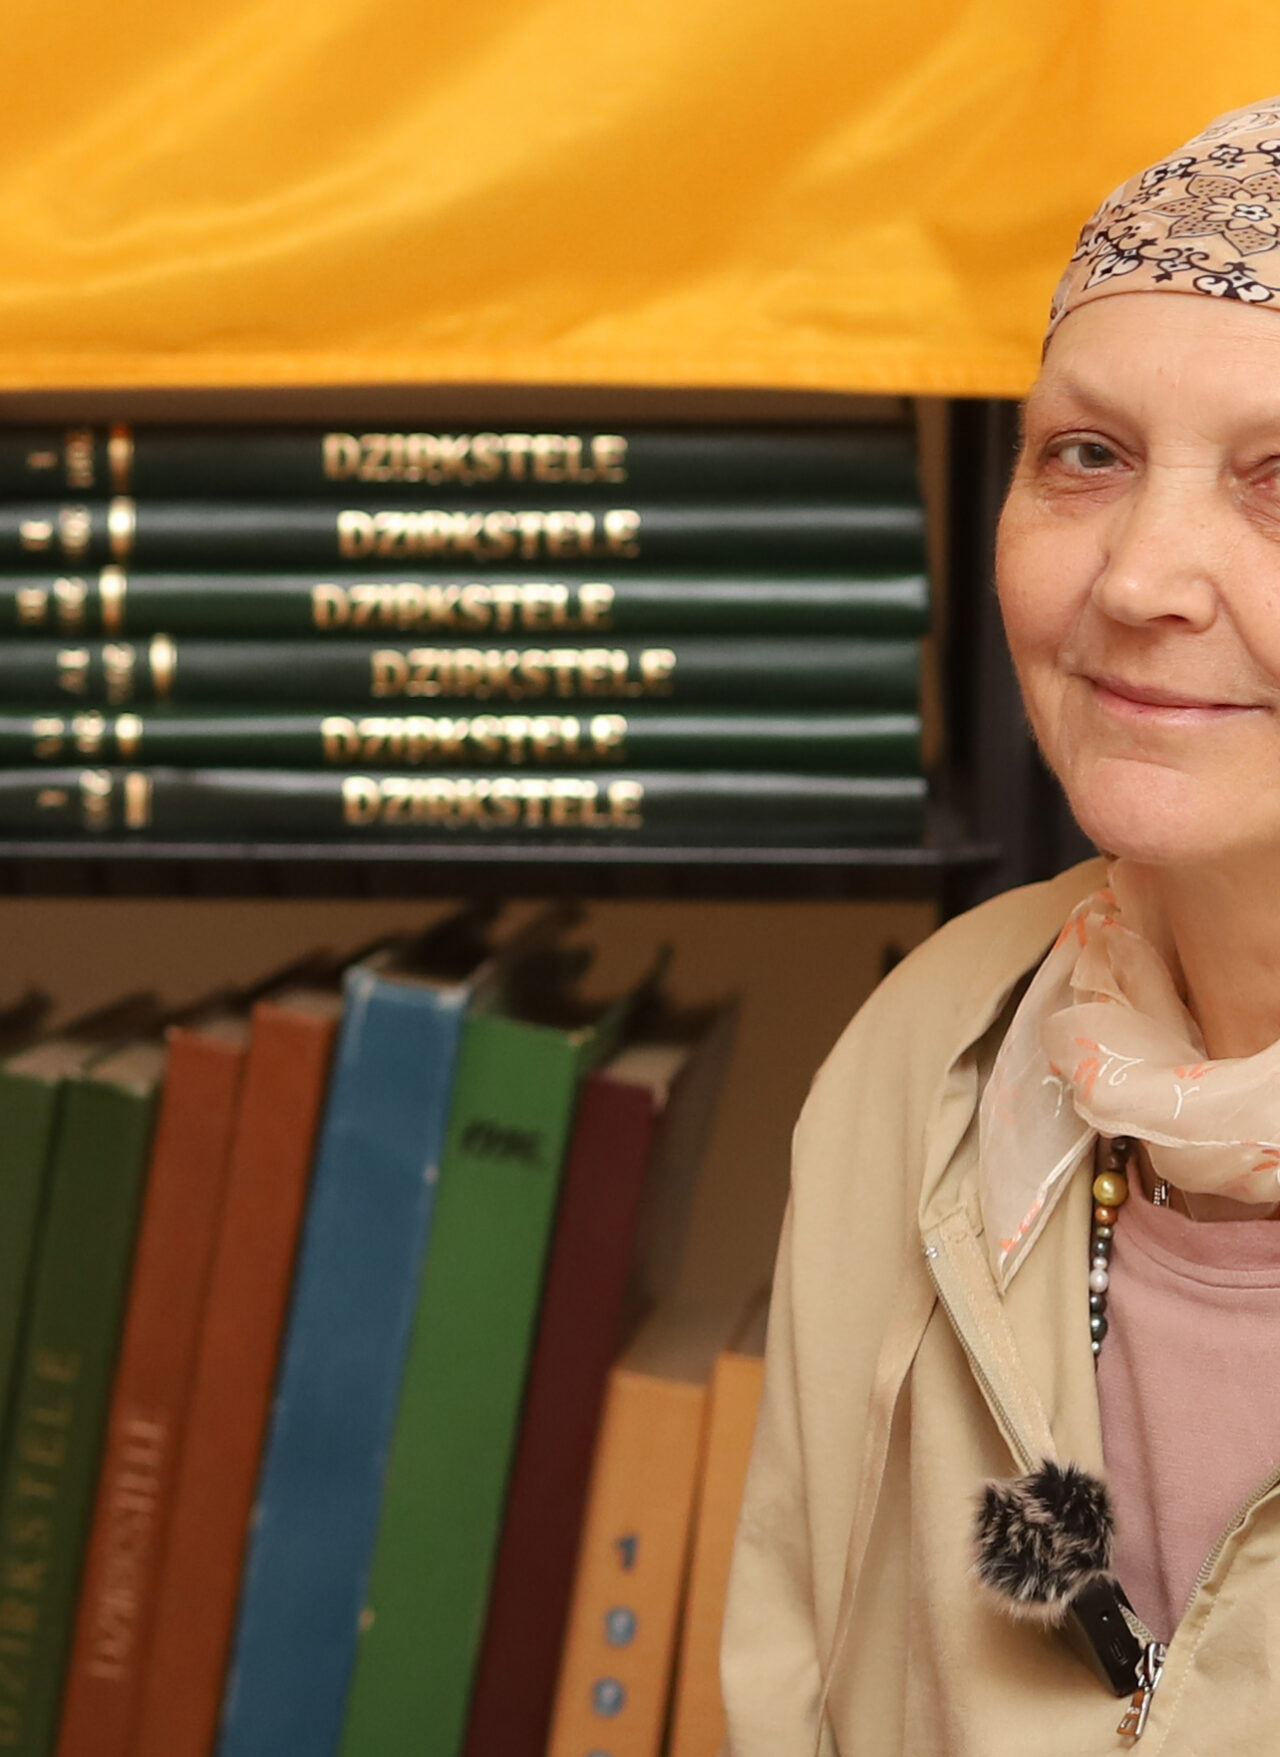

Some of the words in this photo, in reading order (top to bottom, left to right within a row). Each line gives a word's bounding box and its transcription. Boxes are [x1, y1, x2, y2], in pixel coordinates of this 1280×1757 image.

[322, 433, 628, 483] DZIRKSTELE
[336, 509, 641, 558] DZIRKSTELE
[311, 583, 615, 631] DZIRKSTELE
[370, 648, 676, 698] DZIRKSTELE
[319, 714, 628, 763] DZIRKSTELE
[341, 775, 644, 829] DZIRKSTELE
